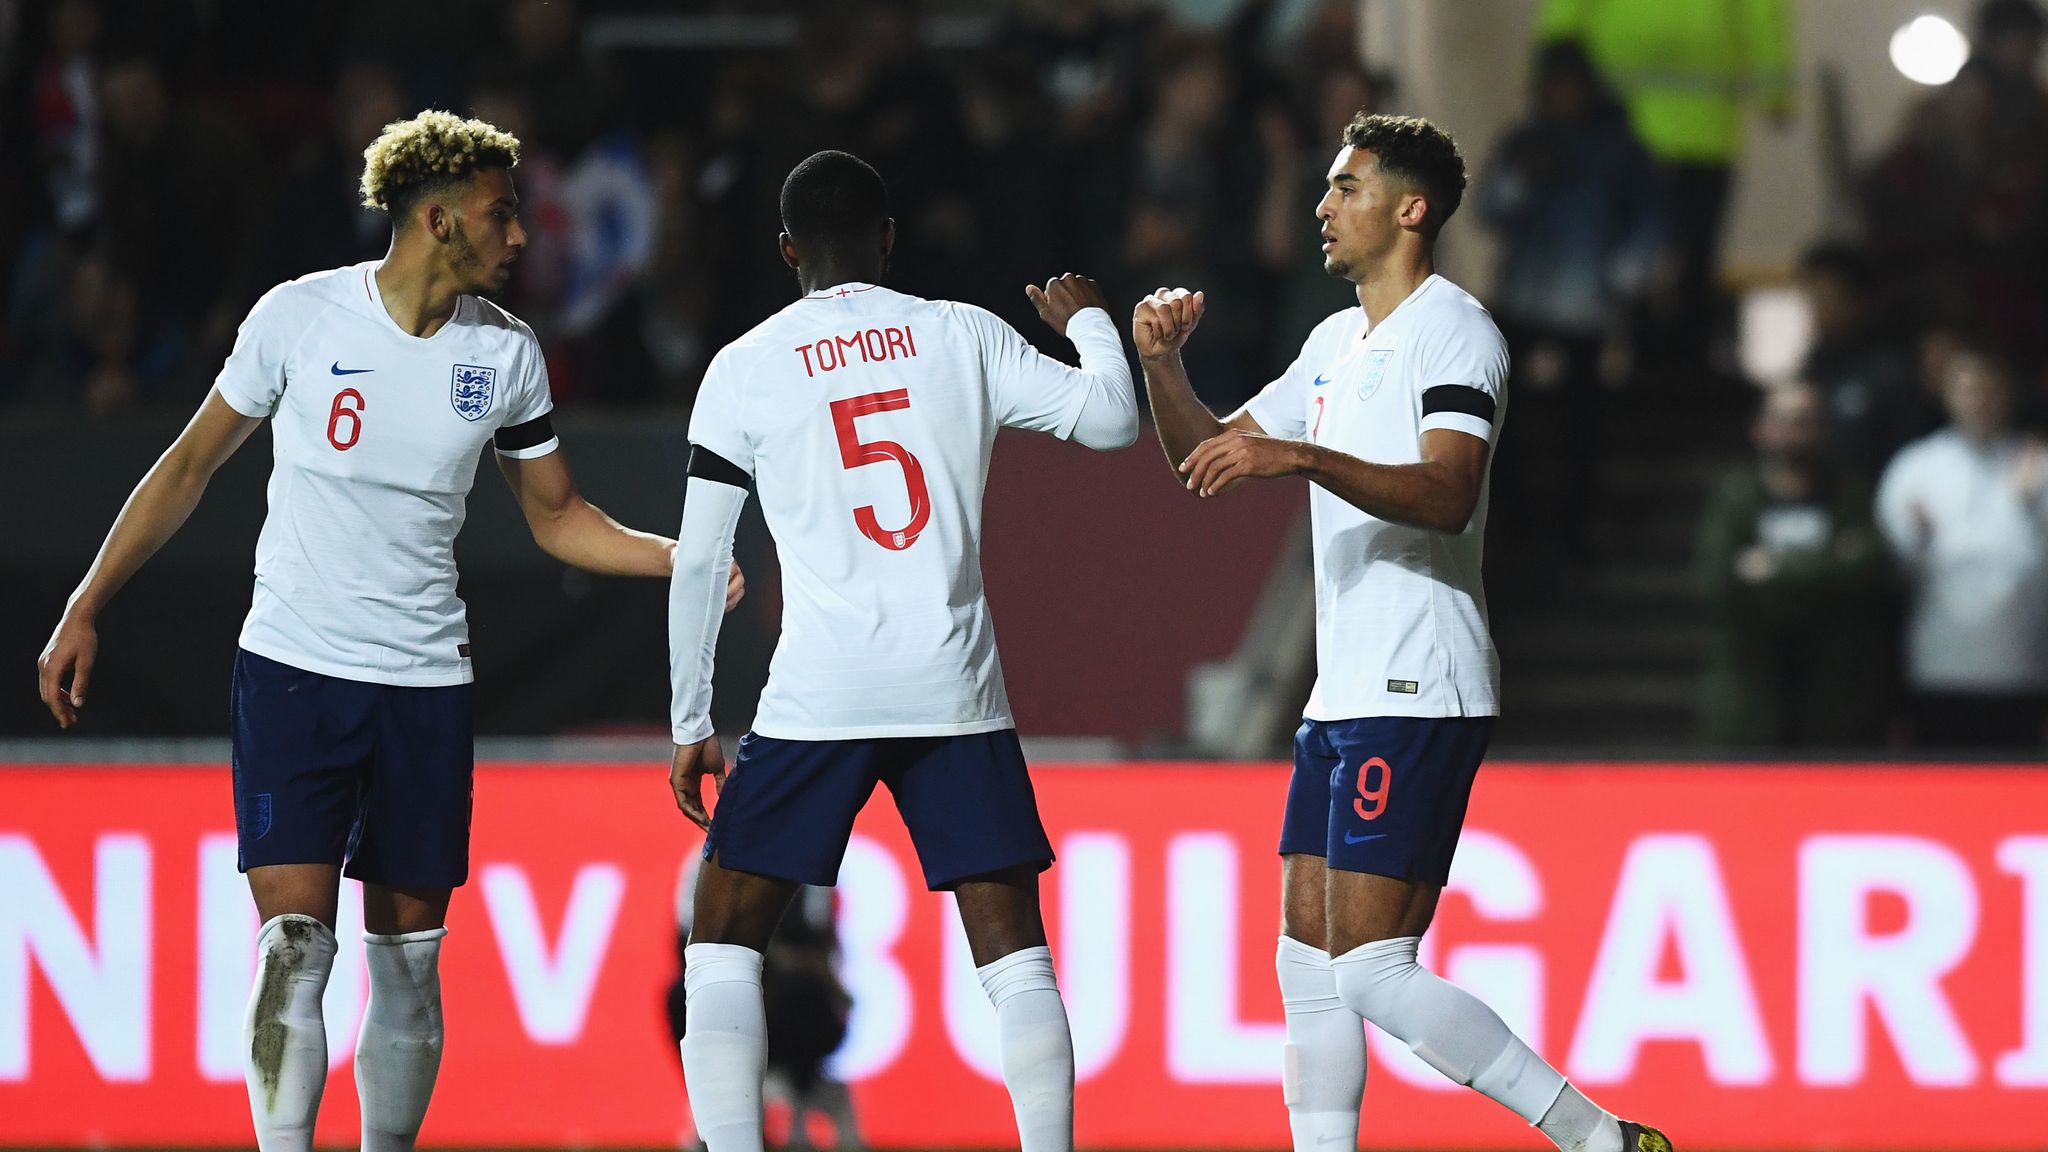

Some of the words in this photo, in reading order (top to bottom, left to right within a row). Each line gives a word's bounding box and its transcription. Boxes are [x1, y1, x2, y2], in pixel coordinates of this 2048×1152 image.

[795, 325, 917, 377] TOMORI
[326, 388, 365, 451] 6
[829, 388, 931, 551] 5
[1353, 756, 1392, 821] 9
